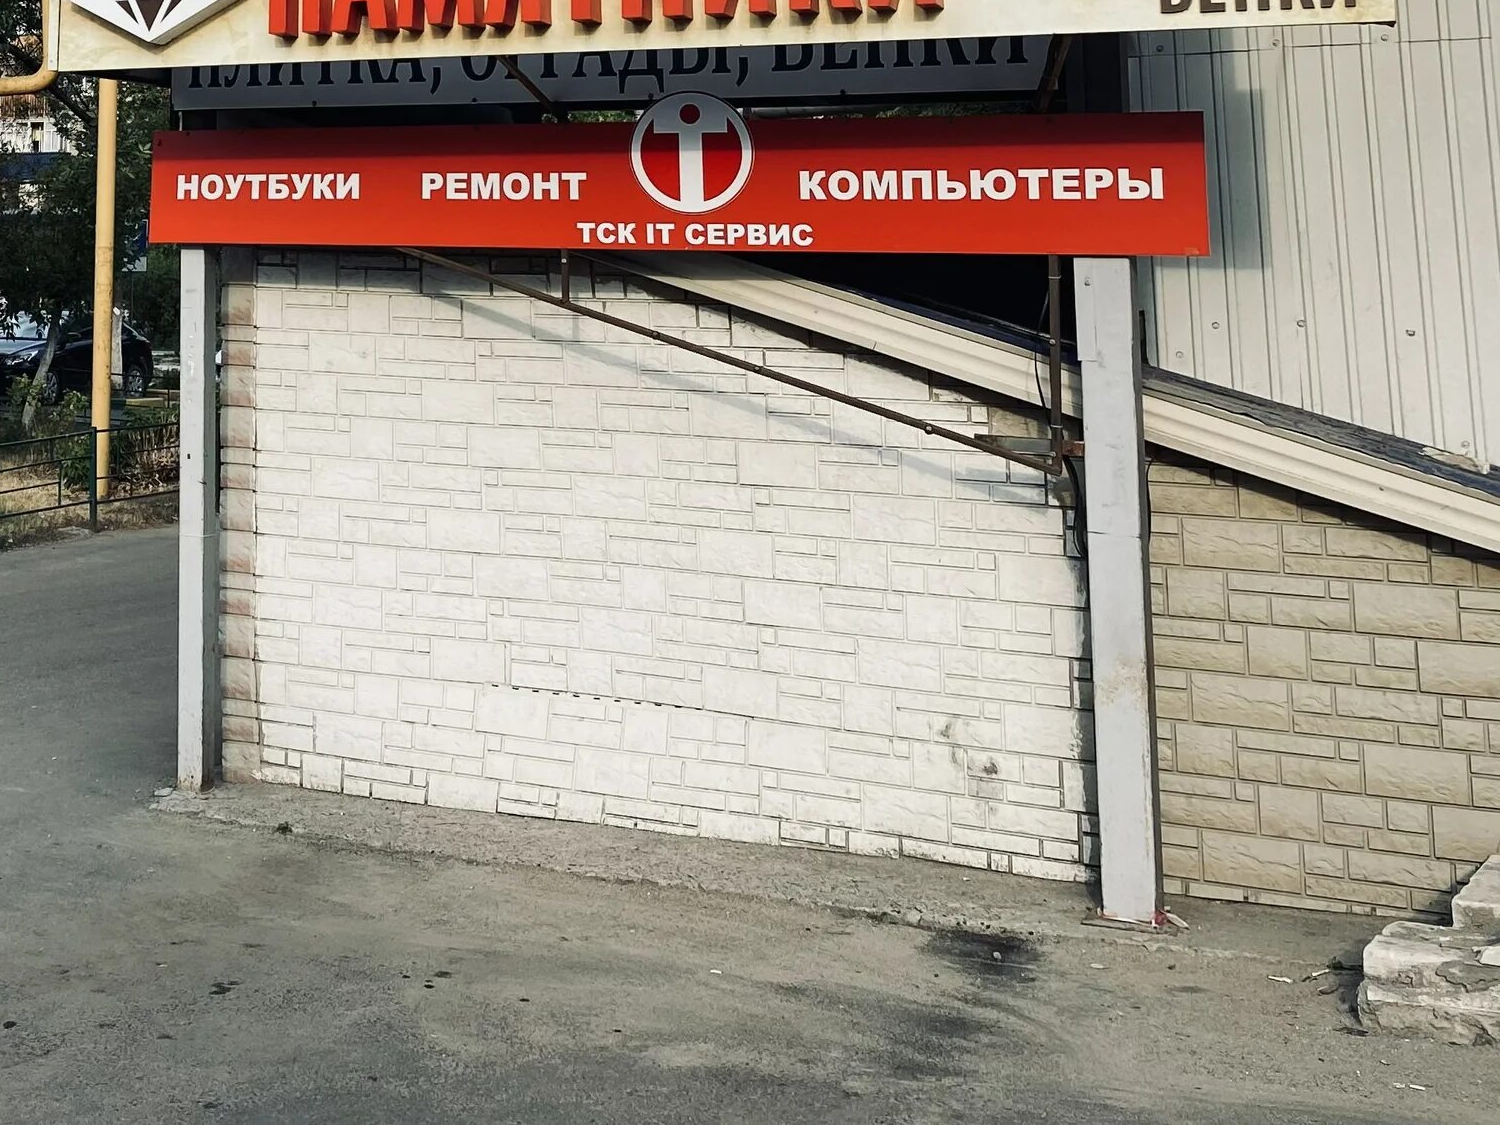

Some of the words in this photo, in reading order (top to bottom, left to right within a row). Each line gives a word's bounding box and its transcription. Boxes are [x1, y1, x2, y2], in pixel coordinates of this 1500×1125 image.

[176, 172, 361, 201] НОУТБУКИ
[421, 171, 587, 201] РЕМОНТ
[799, 167, 1164, 201] КОМПЬЮТЕРЫ
[576, 222, 636, 245] ТСК
[645, 222, 675, 245] IT
[684, 222, 814, 246] СЕРВИС
